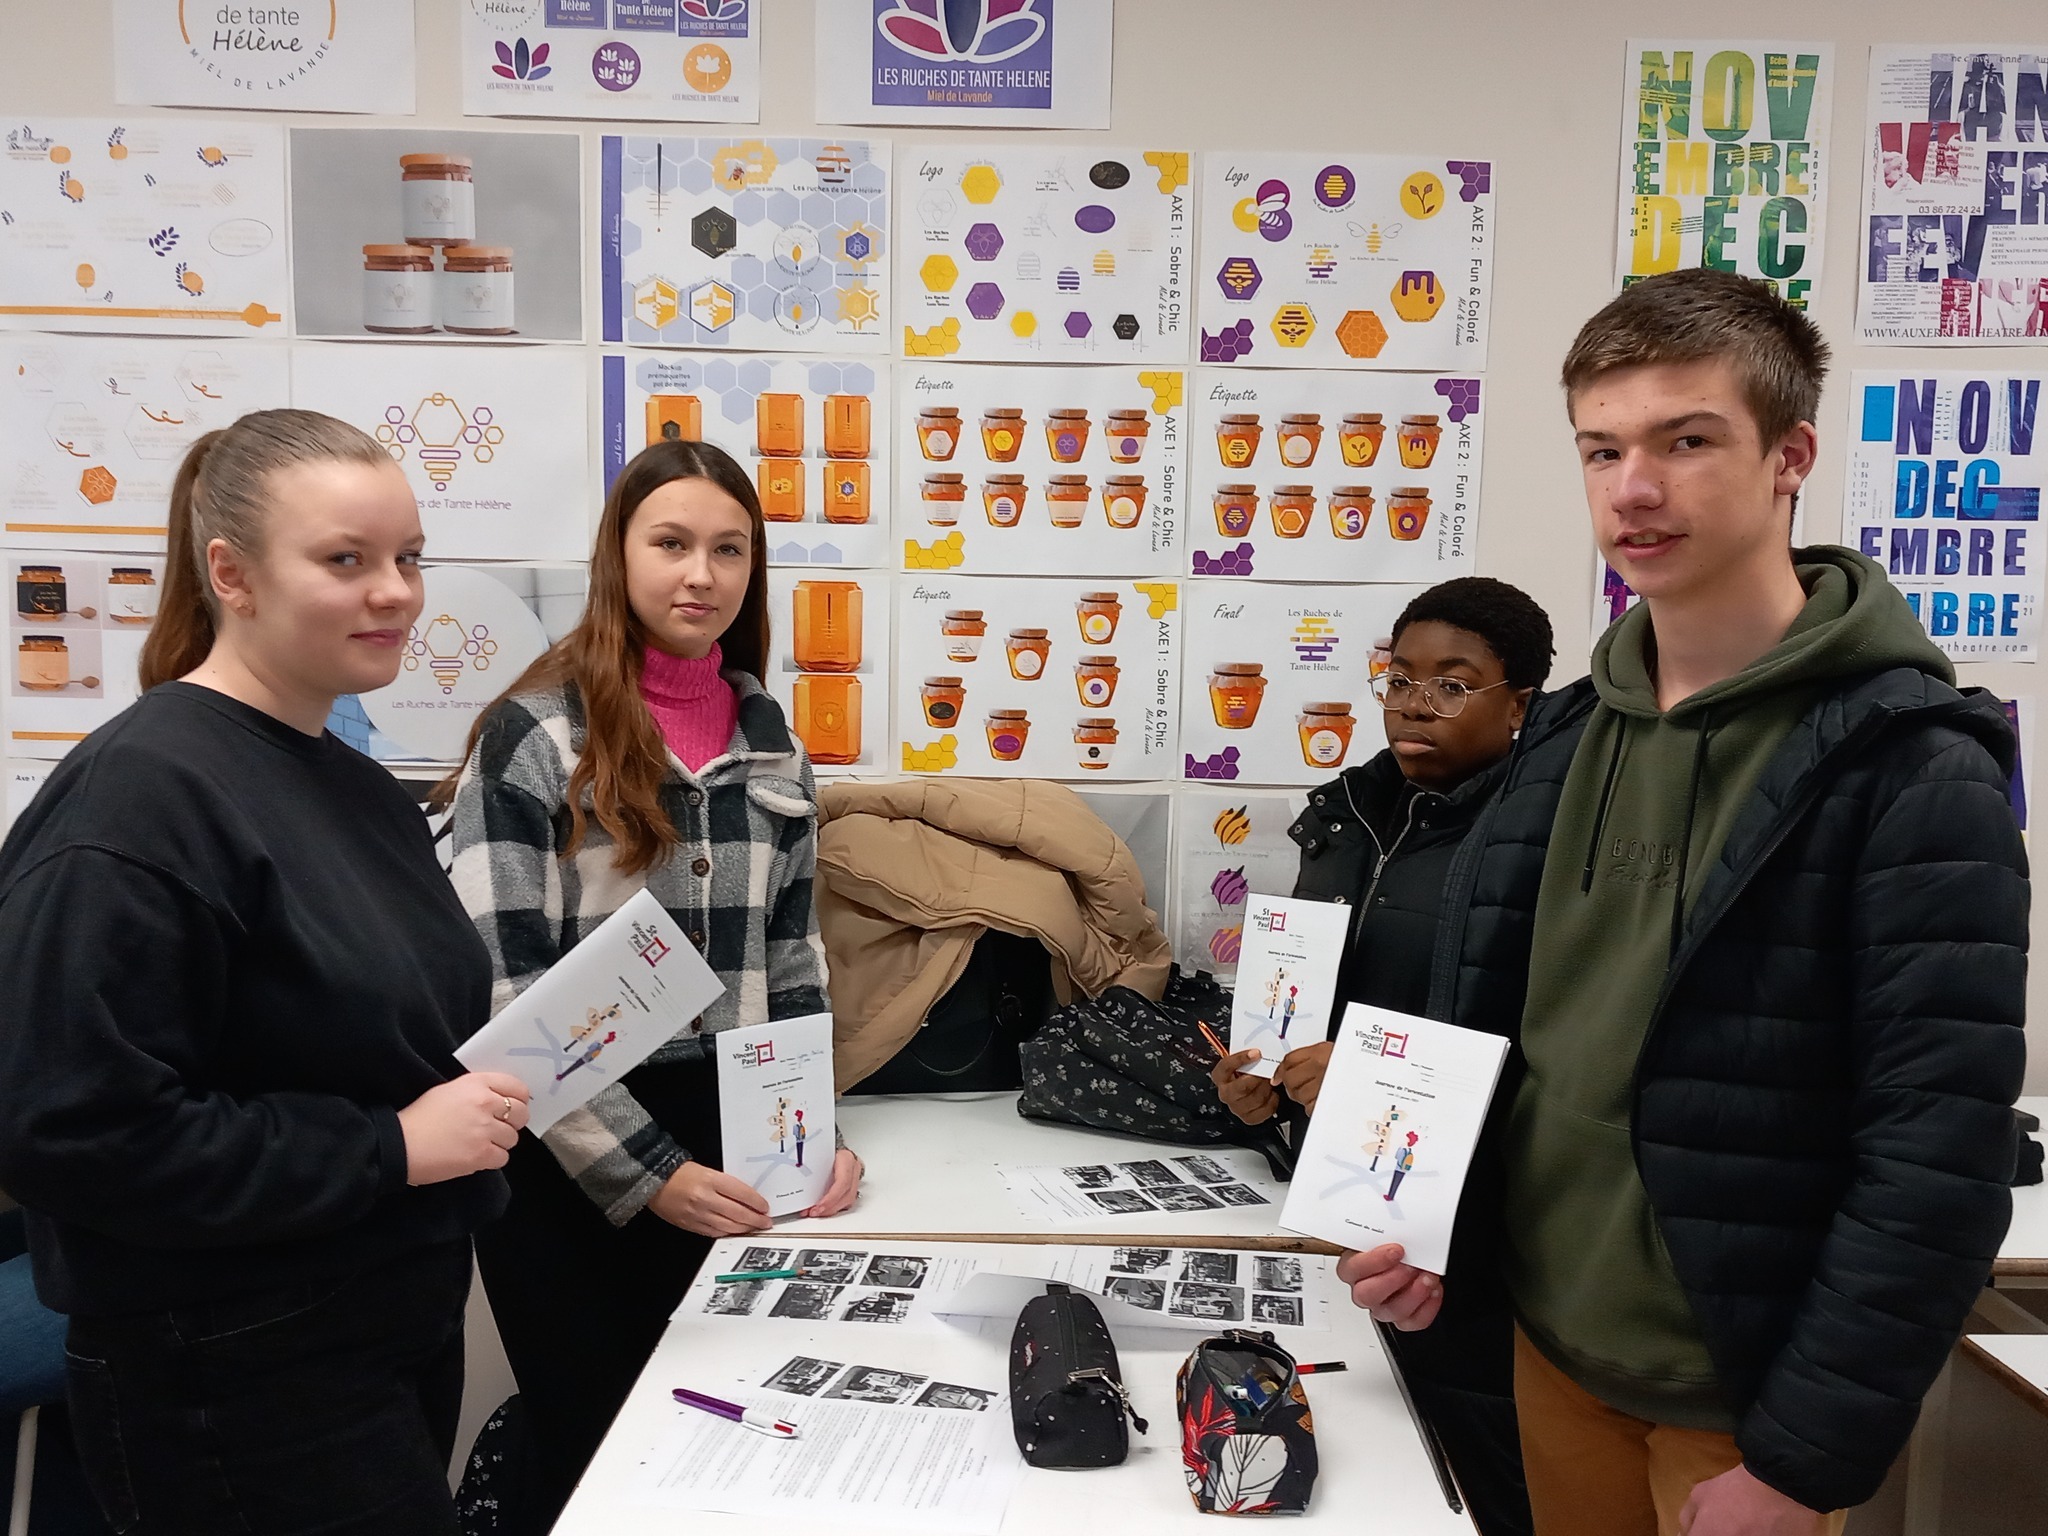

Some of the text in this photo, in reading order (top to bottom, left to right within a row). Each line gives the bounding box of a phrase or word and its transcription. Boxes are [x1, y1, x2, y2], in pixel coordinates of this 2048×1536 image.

[216, 4, 300, 26] de tante
[212, 27, 303, 52] Hélène
[190, 42, 330, 91] MIEL DE LAVANDE
[877, 67, 1051, 89] LES RUCHES DE TANTE HELENE
[927, 90, 993, 103] Miel de Lavande
[1637, 50, 1820, 142] NOV
[919, 160, 944, 182] Logo
[1224, 166, 1250, 187] Logo
[1635, 142, 1811, 196] EMBRE
[1171, 195, 1183, 222] AXE
[1472, 205, 1484, 232] AXE
[1918, 206, 1981, 214] 03 86 72 24 24
[1471, 235, 1483, 244] 2
[1631, 196, 1808, 279] DEC
[1169, 246, 1182, 286] Sobre
[1470, 258, 1483, 283] Fun
[1169, 290, 1181, 299] &
[1469, 287, 1481, 296] &
[1168, 303, 1181, 332] Chic
[1466, 299, 1481, 344] Coloré
[1209, 382, 1258, 407] Étiquette
[1895, 379, 2041, 456] NOV
[1164, 415, 1176, 443] AXE
[1459, 422, 1471, 449] AXE
[1458, 452, 1470, 460] 2
[1163, 465, 1176, 503] Sobre
[1456, 474, 1469, 500] Fun
[1895, 459, 2001, 519] DEC
[428, 498, 441, 509] de
[444, 499, 473, 509] Tante
[475, 498, 512, 510] Hélène
[1162, 507, 1175, 515] &
[1455, 503, 1467, 512] &
[1161, 520, 1174, 548] Chic
[1451, 515, 1467, 558] Coloré
[1860, 527, 2027, 576] EMBRE
[1213, 603, 1245, 619] Final
[1288, 608, 1343, 618] Les Ruches de
[1157, 620, 1170, 647] AXE
[1290, 662, 1340, 672] Tante Hélène
[1156, 669, 1170, 706] Sobre
[392, 700, 404, 709] Les
[406, 700, 435, 709] Ruches
[437, 700, 448, 709] de
[449, 700, 473, 710] Tante
[1155, 709, 1168, 717] &
[1155, 721, 1168, 748] Chic
[1262, 907, 1270, 916] St
[1257, 920, 1270, 928] Paul
[1355, 1030, 1384, 1043] Vincent
[1371, 1024, 1383, 1035] St
[732, 1051, 756, 1060] Vincent
[744, 1043, 754, 1052] St
[1361, 1040, 1381, 1051] Paul
[741, 1057, 757, 1066] Paul
